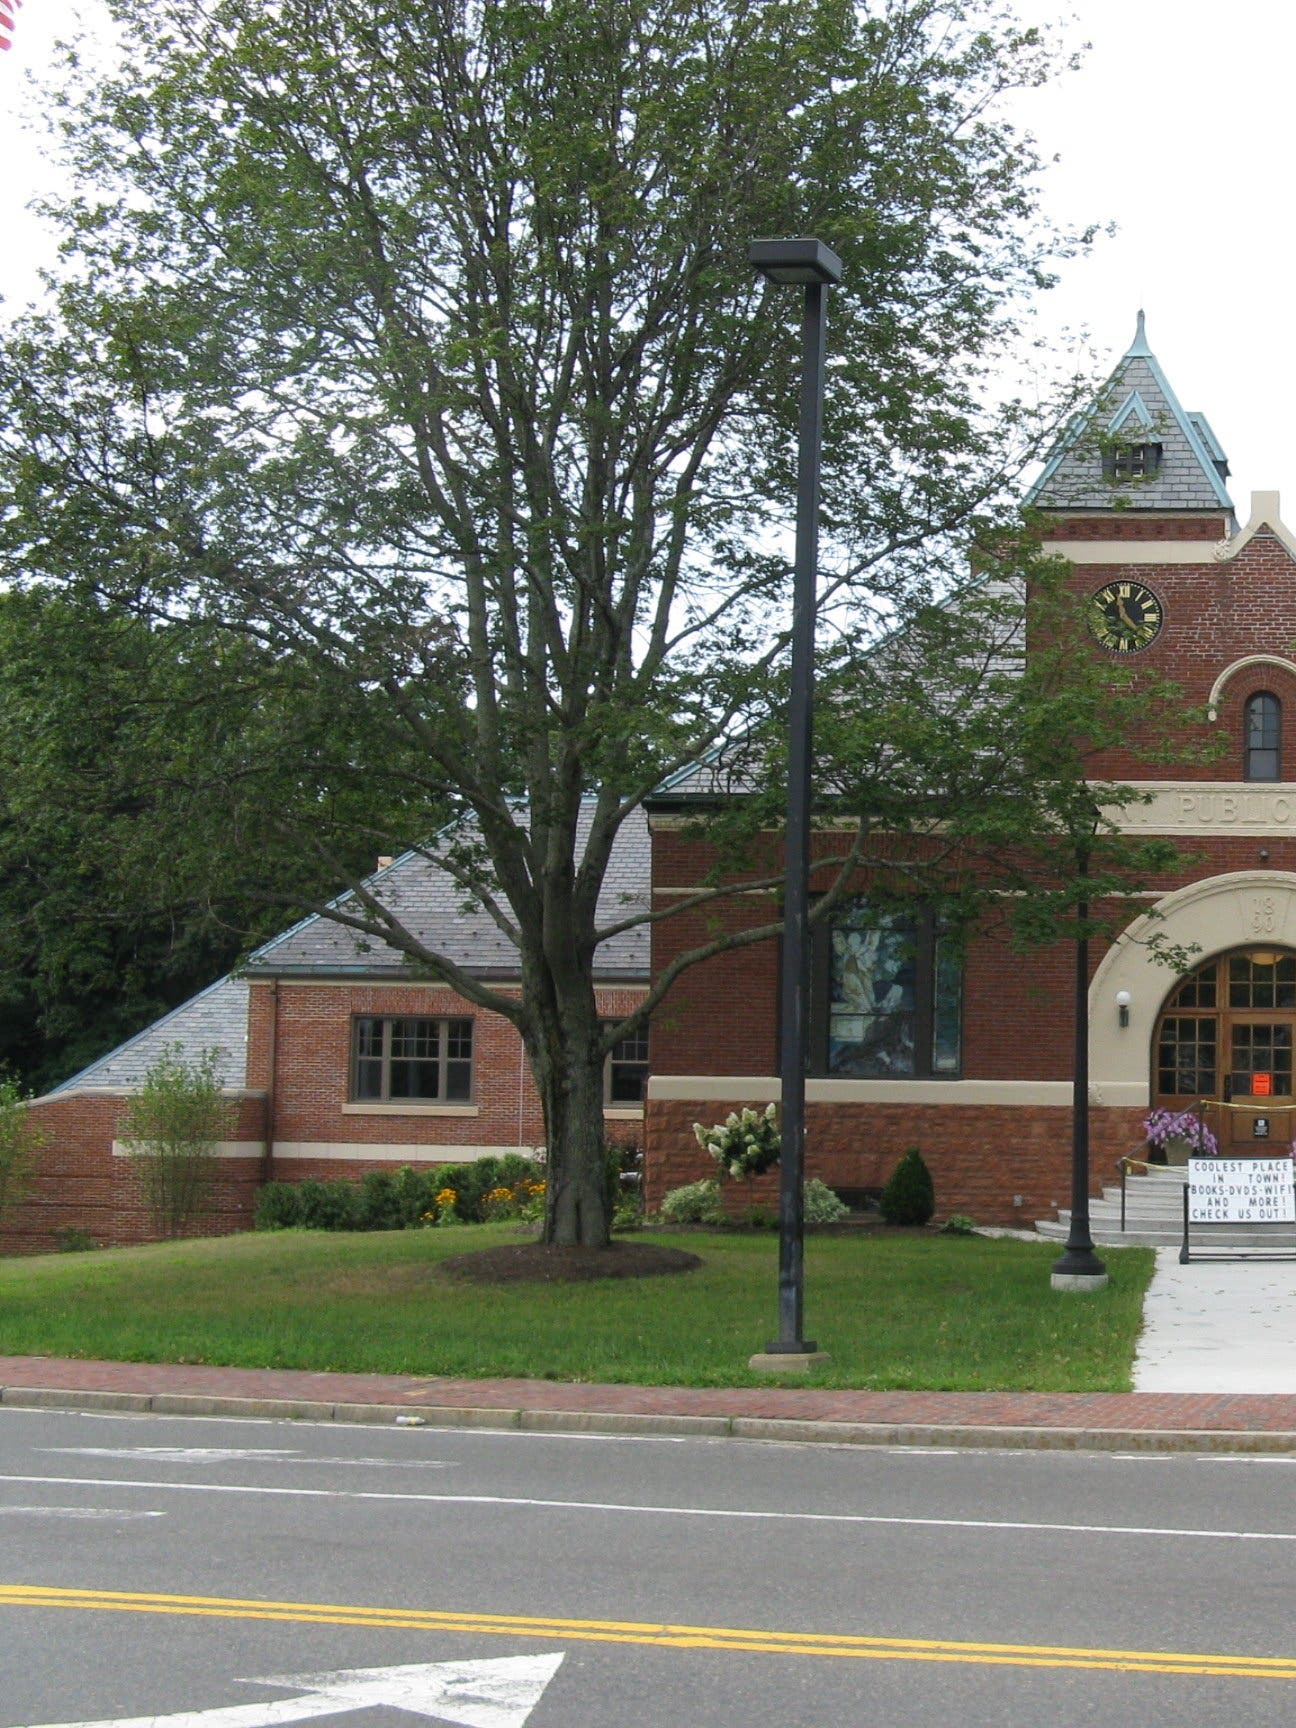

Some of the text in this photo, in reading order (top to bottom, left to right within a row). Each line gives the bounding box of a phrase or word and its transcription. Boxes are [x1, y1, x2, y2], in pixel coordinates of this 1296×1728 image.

[1176, 796, 1291, 824] PUBLIC
[1194, 1161, 1289, 1172] COOLEST PLACE
[1212, 1173, 1286, 1183] IN TOWN!
[1207, 1197, 1286, 1207] AND MORE!
[1192, 1208, 1287, 1219] CHECK US OUT!
